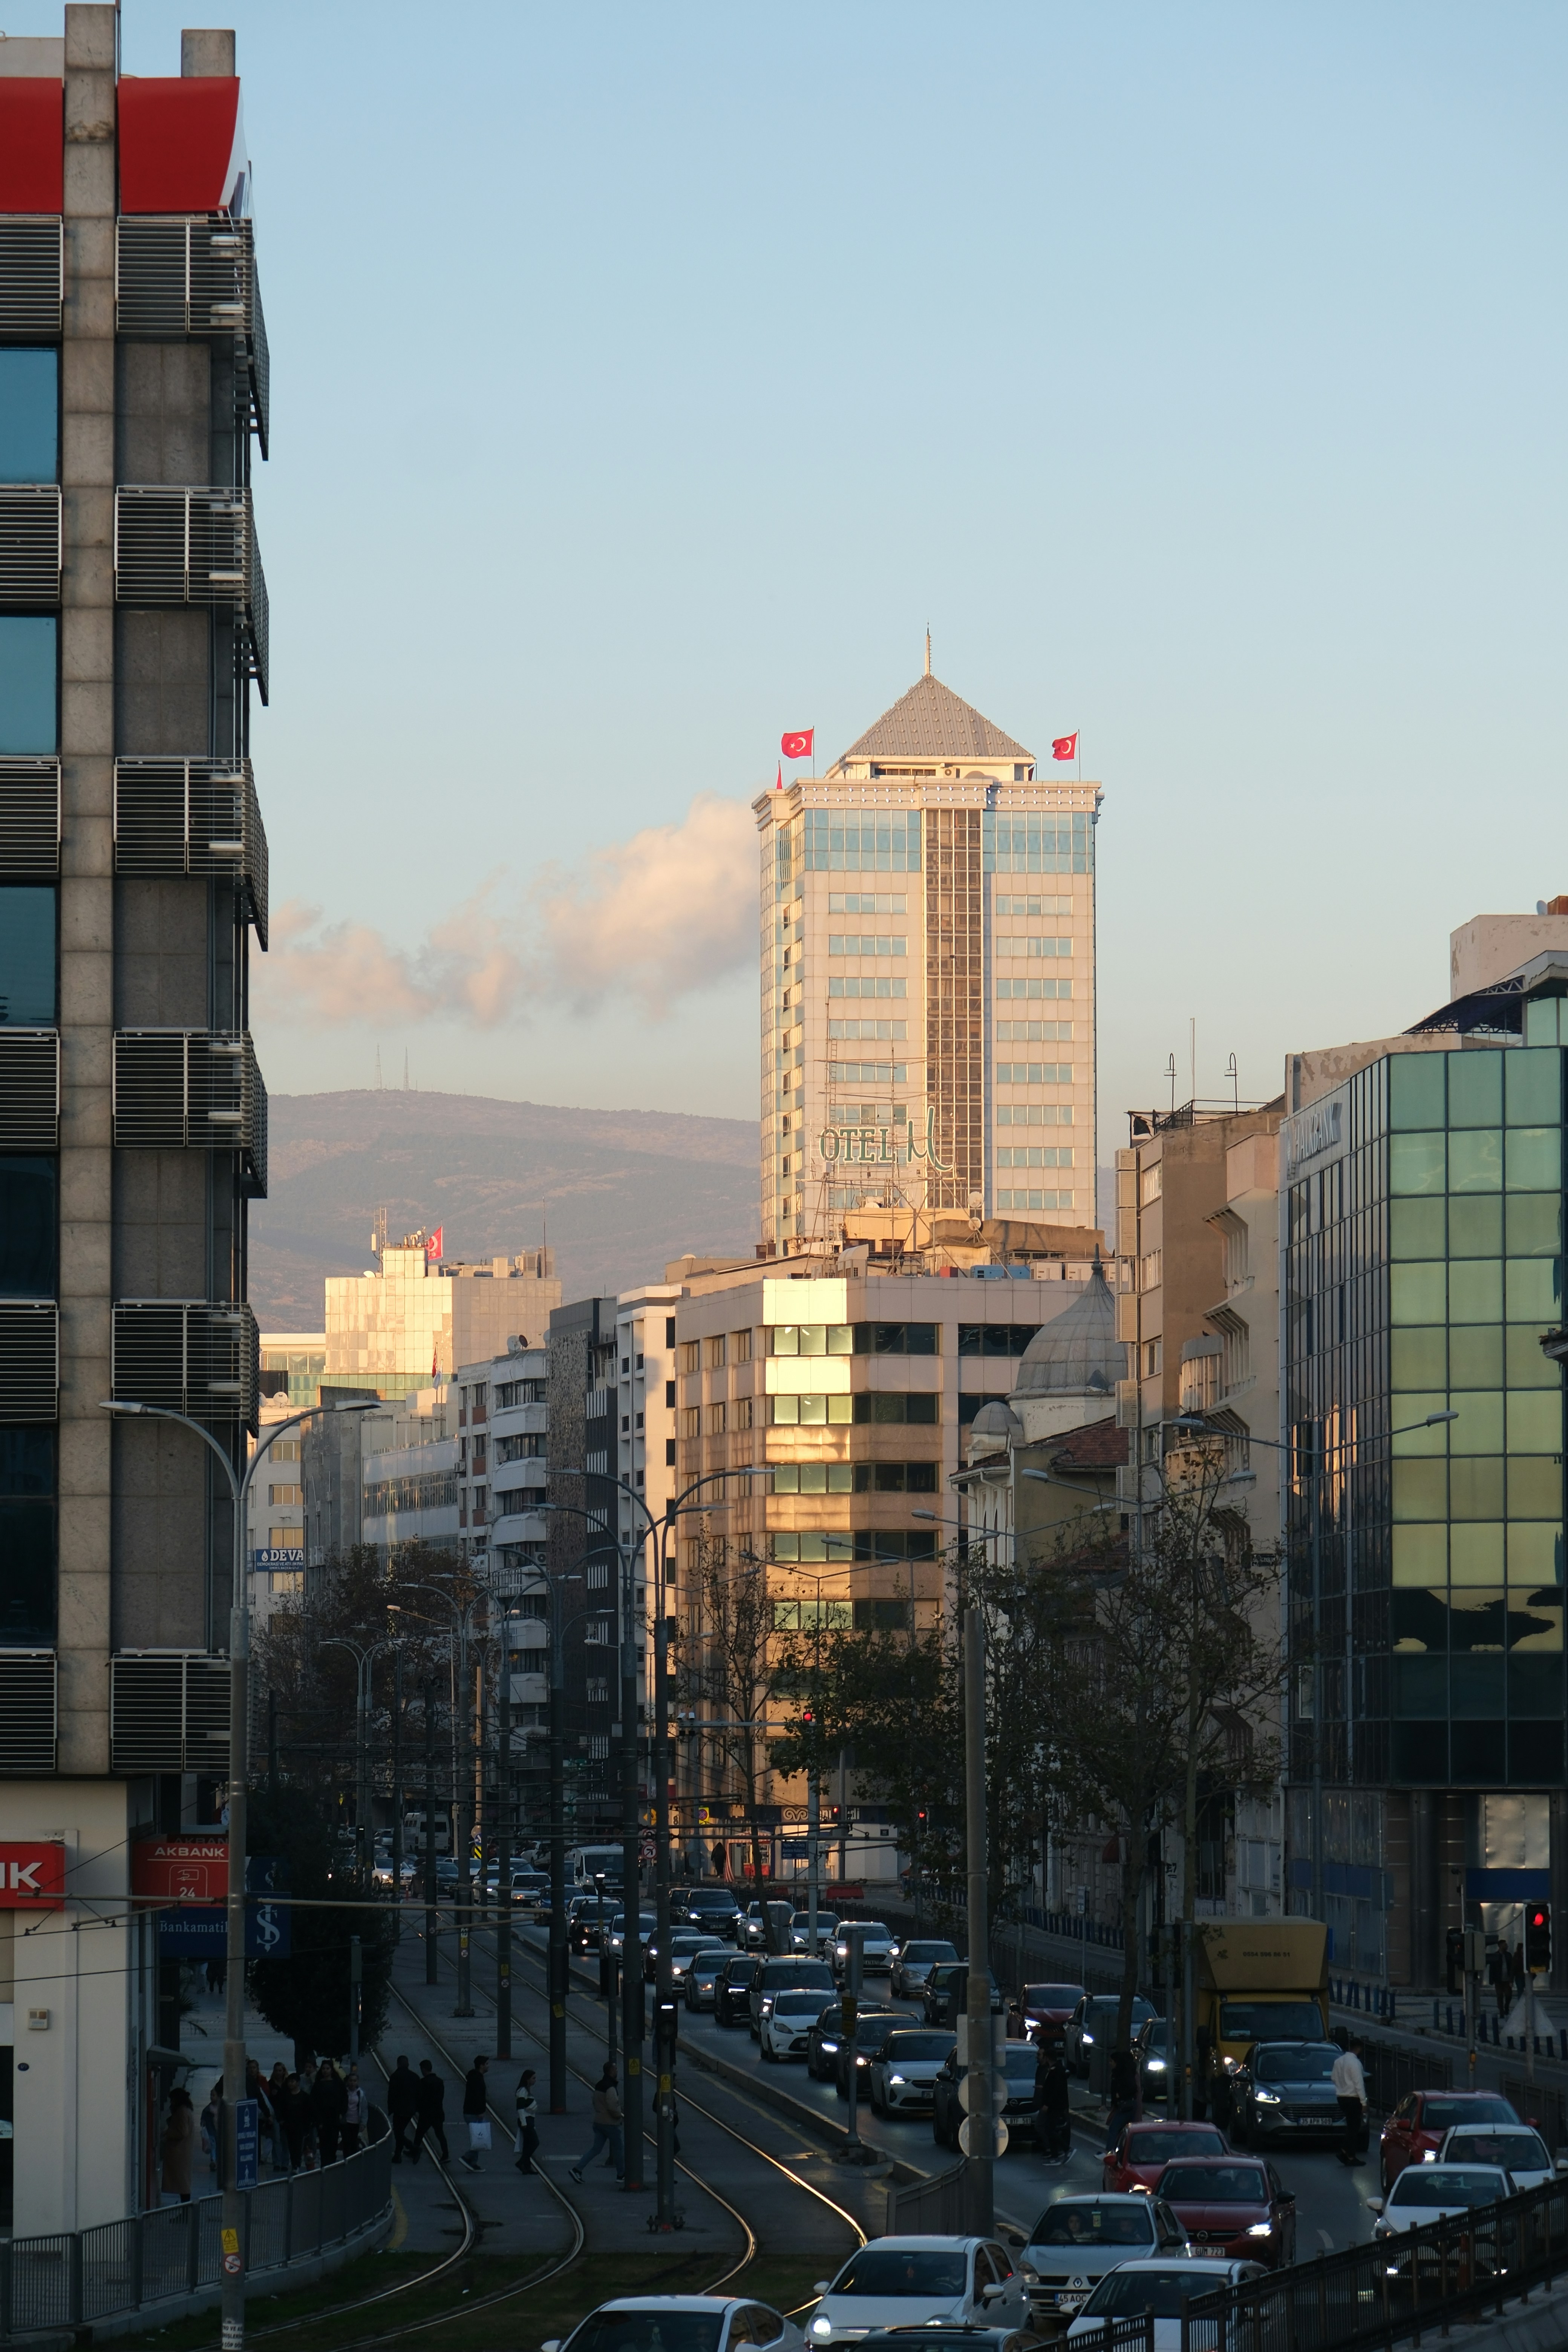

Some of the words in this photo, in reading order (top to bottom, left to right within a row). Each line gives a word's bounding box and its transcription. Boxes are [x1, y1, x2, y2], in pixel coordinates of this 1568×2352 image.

[1295, 1103, 1337, 1163] HALKBANK
[819, 1126, 897, 1163] OTEL
[270, 1550, 303, 1561] DEVA
[155, 1847, 225, 1857] AKBANK
[179, 1886, 195, 1897] 24
